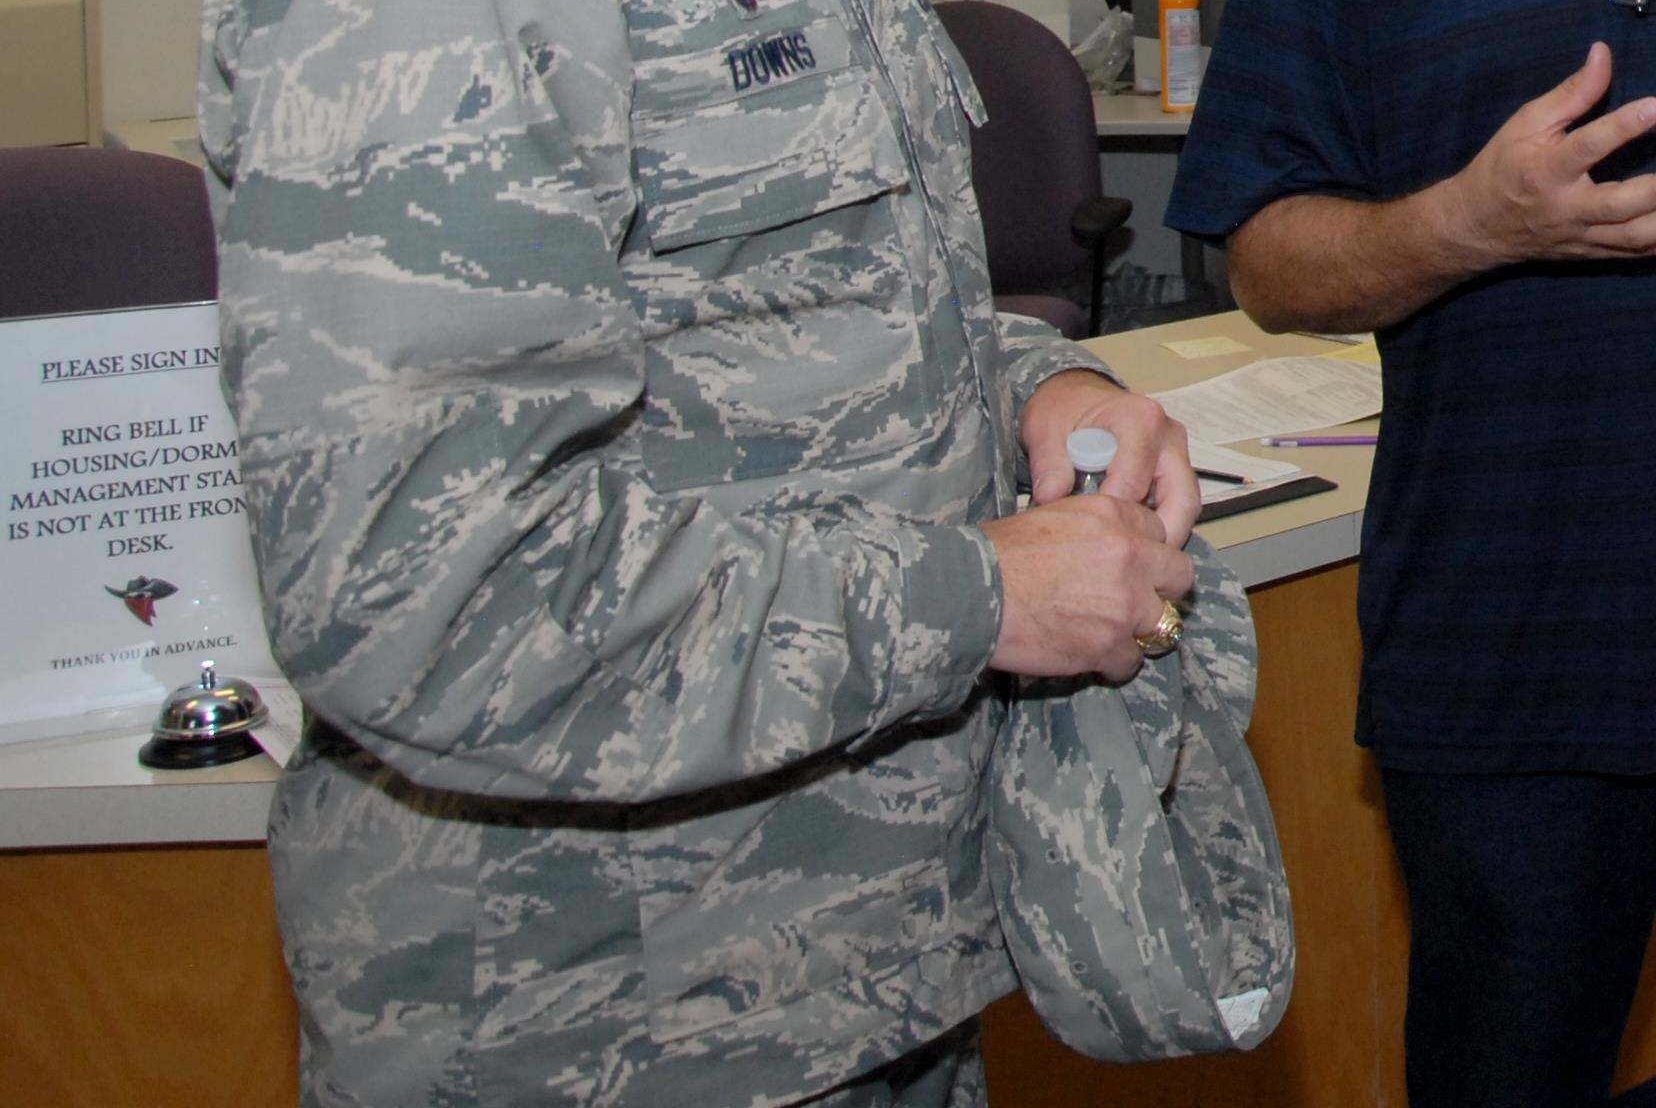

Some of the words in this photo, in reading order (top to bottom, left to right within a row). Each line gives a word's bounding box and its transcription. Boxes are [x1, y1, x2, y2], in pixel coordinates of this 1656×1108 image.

[728, 33, 816, 92] DOWNS
[42, 356, 124, 380] PLEASE
[131, 348, 187, 372] SIGN
[195, 346, 220, 365] IN
[61, 422, 121, 447] RING
[129, 417, 182, 441] BELL
[190, 414, 209, 434] IF
[32, 440, 237, 480] HOUSING/DORM
[10, 475, 190, 511] MANAGEMENT
[9, 521, 30, 541] IS
[36, 514, 92, 538] NOT
[98, 509, 130, 531] AT
[135, 504, 182, 525] THE
[107, 534, 174, 558] DESK.
[51, 654, 105, 671] THANK
[110, 649, 141, 664] YOU
[145, 644, 161, 659] IN
[163, 635, 238, 657] ADVANCE.
